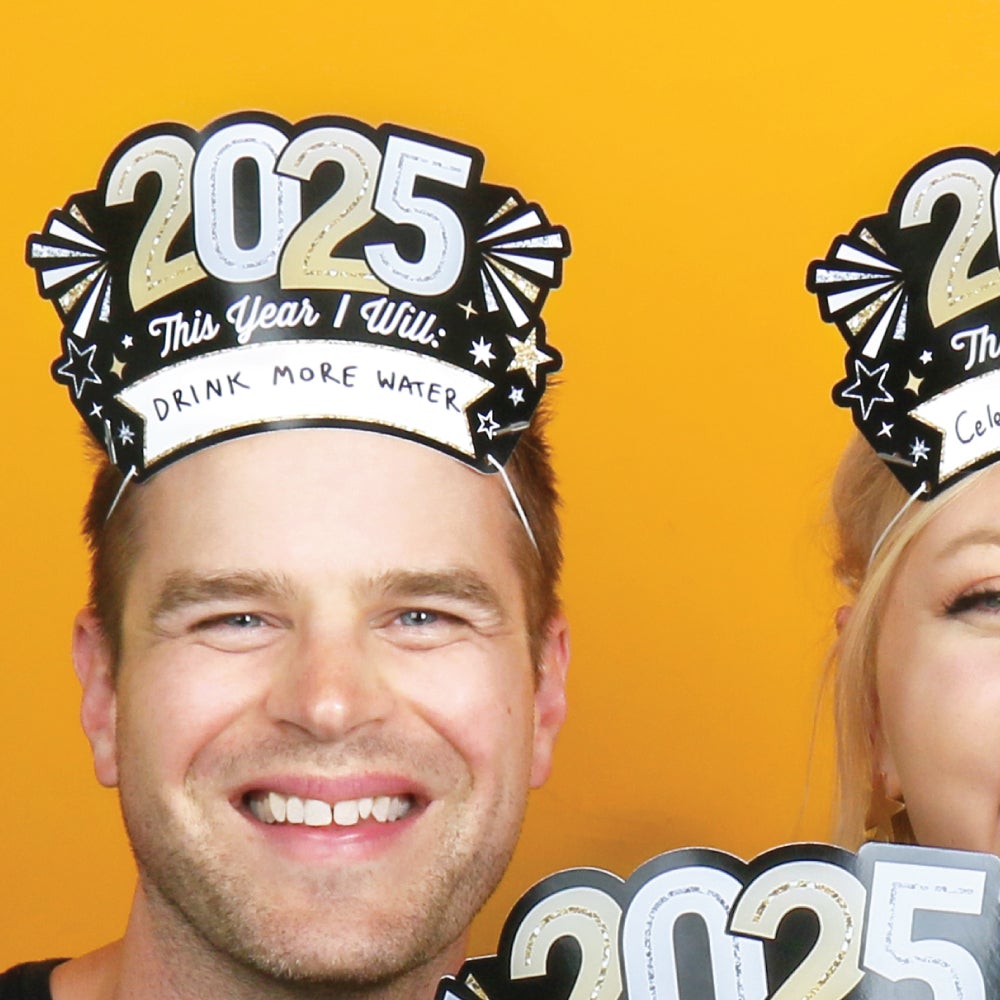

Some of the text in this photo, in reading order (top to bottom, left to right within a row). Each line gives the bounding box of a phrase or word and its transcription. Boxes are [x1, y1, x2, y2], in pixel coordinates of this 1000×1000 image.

[105, 122, 473, 313] 2025
[148, 294, 447, 358] This Year I Will:
[153, 362, 464, 422] DRINK MORE WATER
